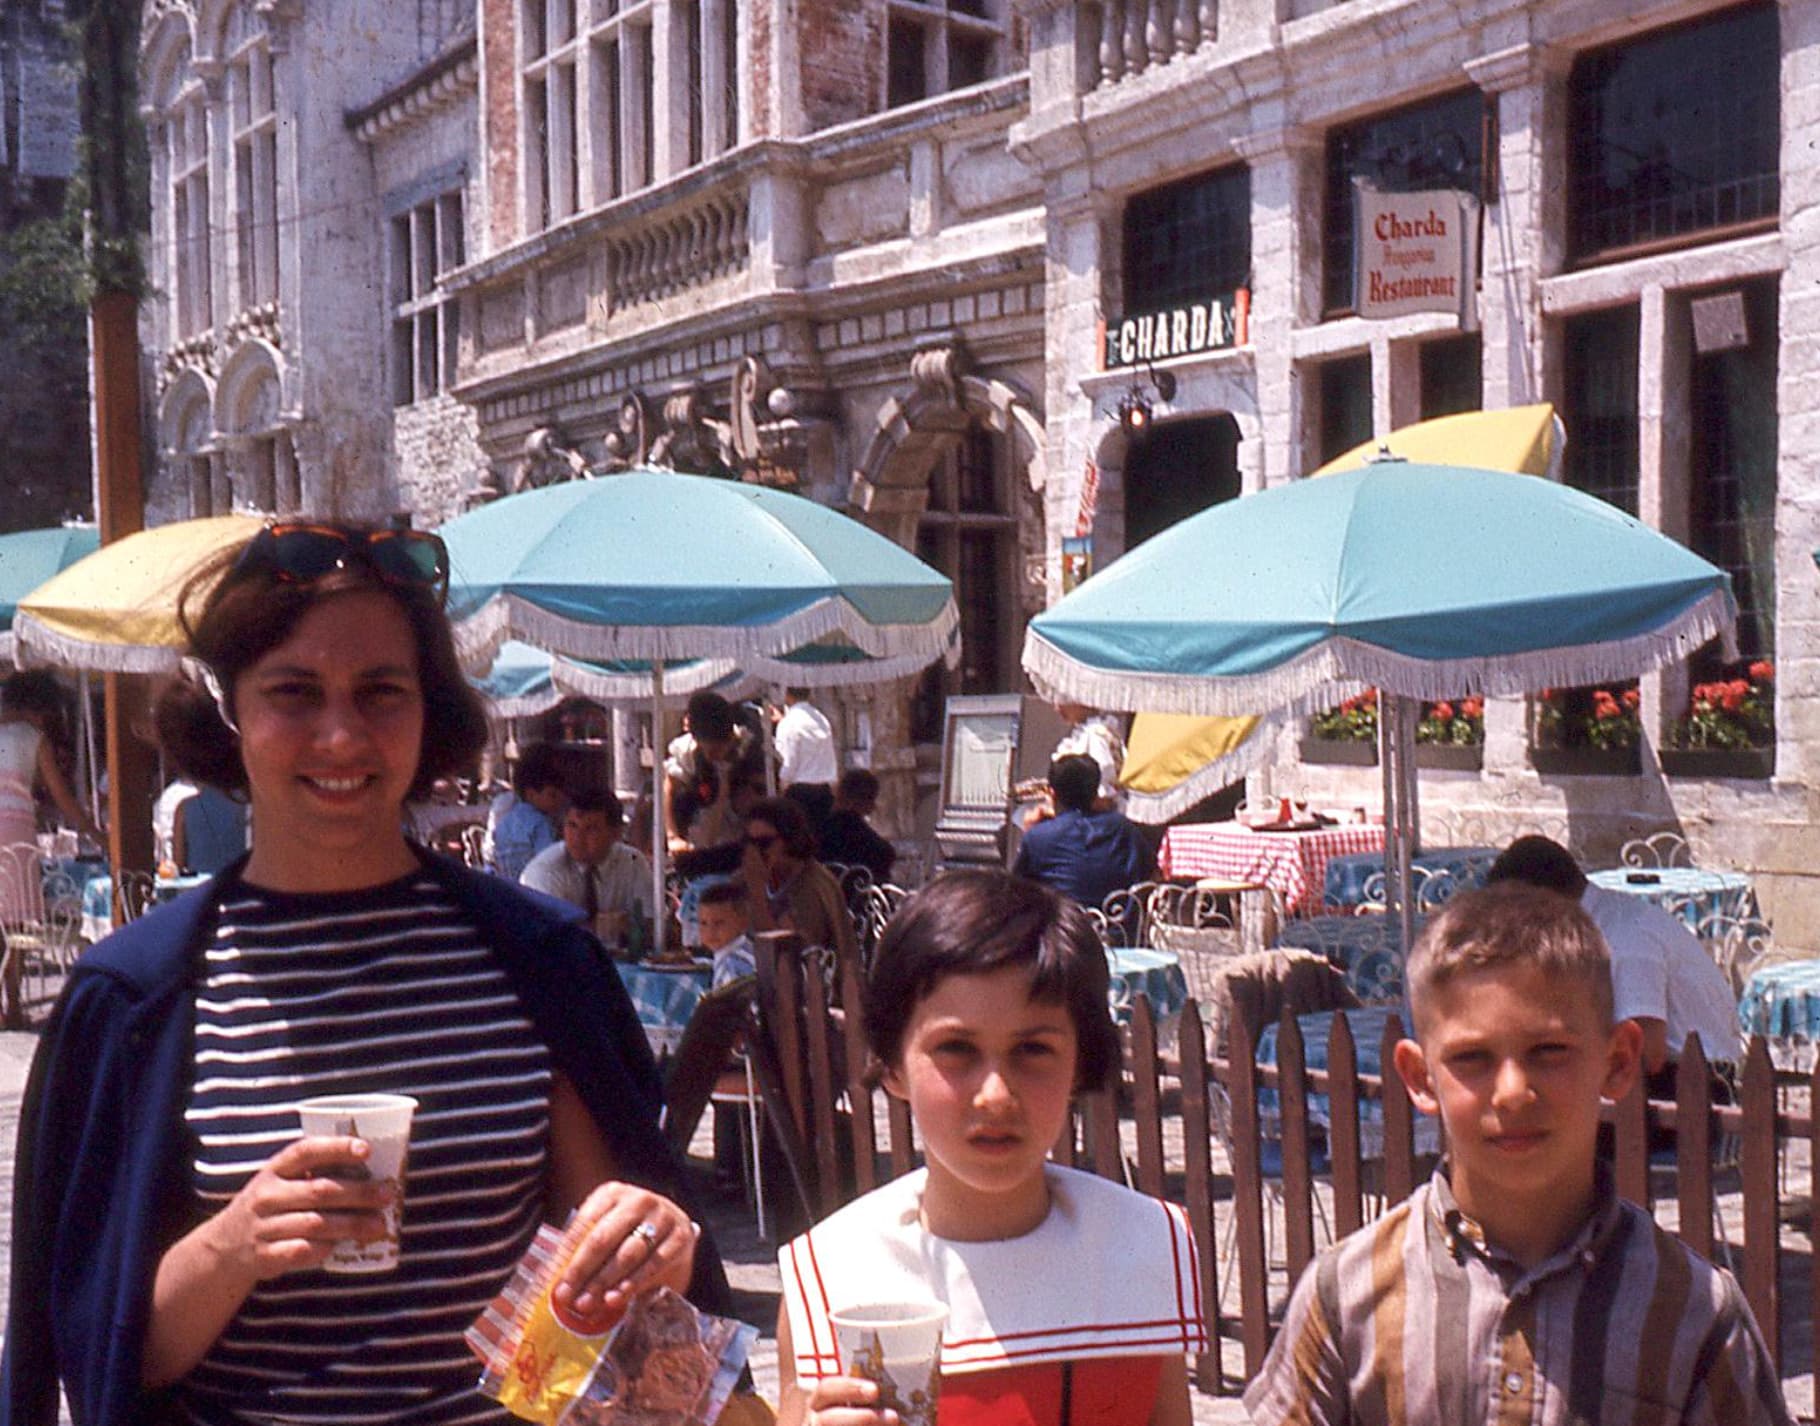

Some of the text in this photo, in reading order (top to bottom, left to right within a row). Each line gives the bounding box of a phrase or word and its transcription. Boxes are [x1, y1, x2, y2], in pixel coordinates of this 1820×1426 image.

[1374, 210, 1446, 241] Charda
[1369, 270, 1456, 302] Restaurant
[1120, 300, 1225, 363] CHARDA
